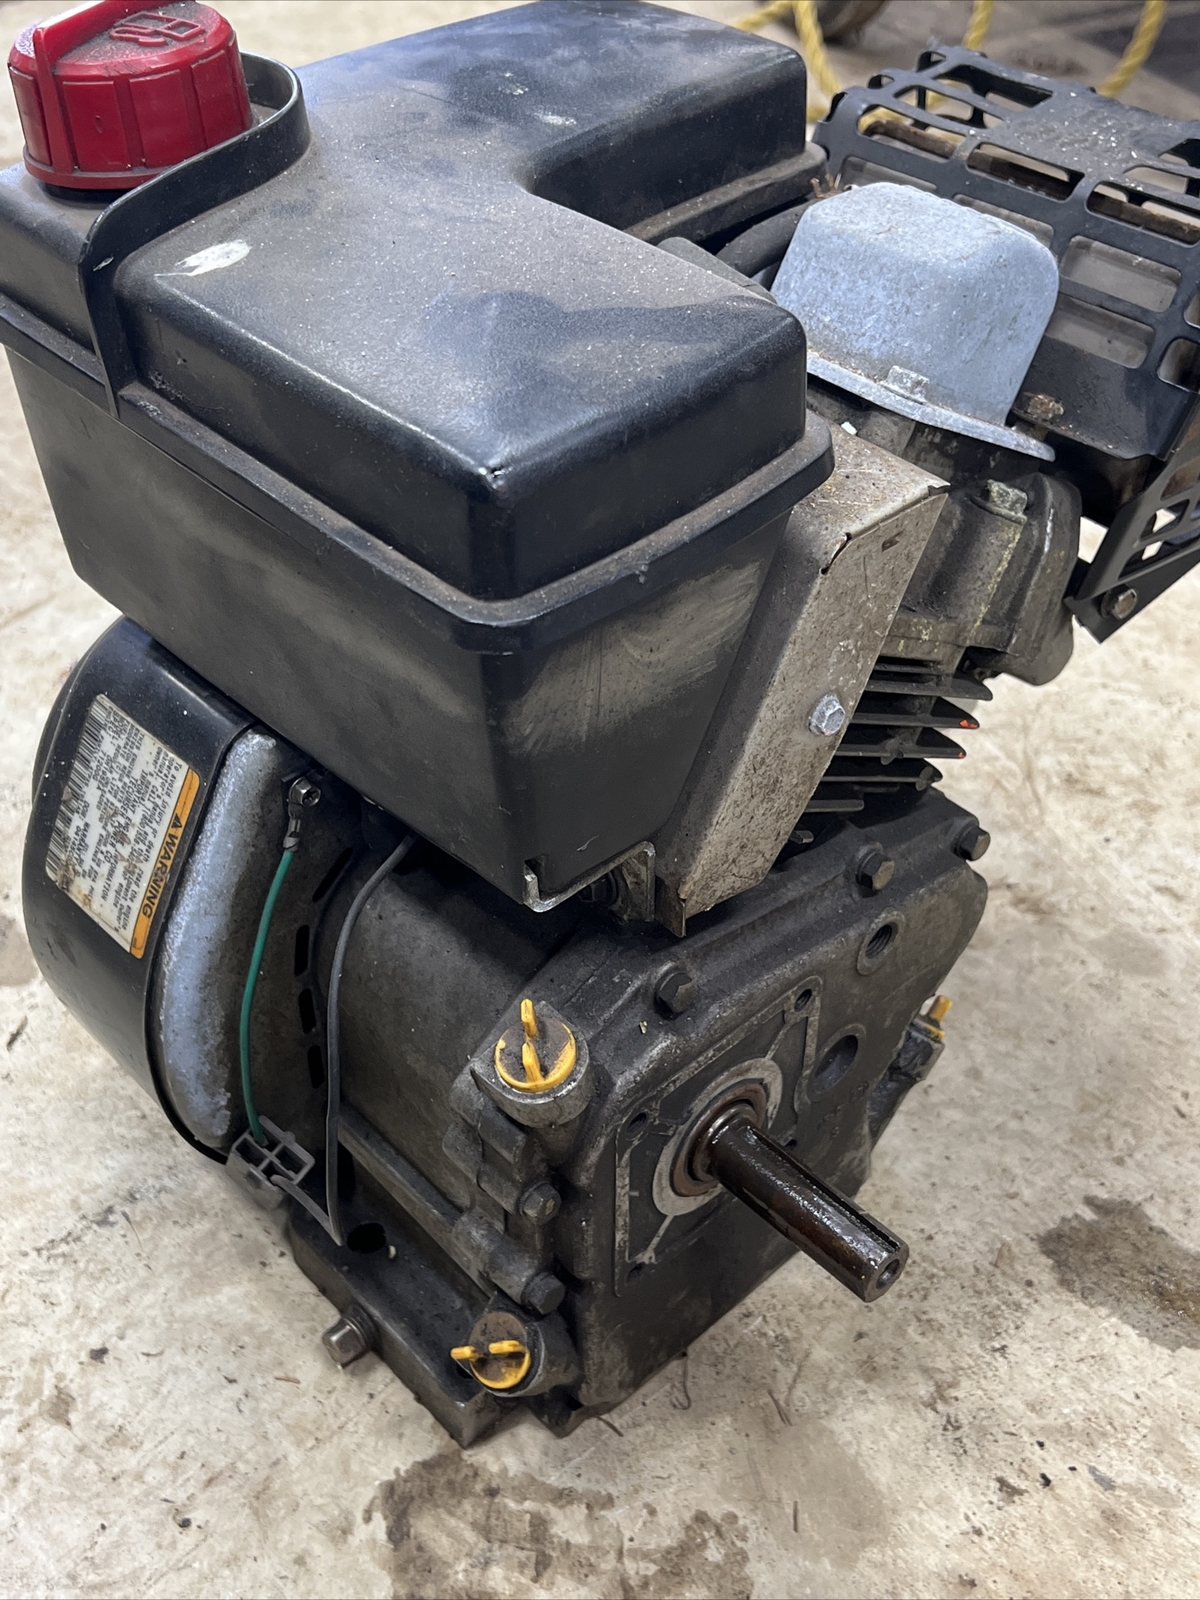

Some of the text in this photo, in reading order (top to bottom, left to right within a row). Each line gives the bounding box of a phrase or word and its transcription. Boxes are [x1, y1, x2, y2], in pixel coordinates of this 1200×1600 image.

[105, 709, 119, 737] SPEC:
[110, 715, 125, 747] MODEL:
[119, 723, 135, 759] MODERATE
[124, 727, 139, 762] EMISSION
[135, 732, 144, 751] THIS
[108, 743, 121, 774] REGULAR
[125, 752, 137, 779] ENGINE
[148, 745, 162, 778] owner's
[173, 760, 181, 773] To
[107, 776, 116, 795] LIFE
[118, 764, 127, 783] REGS
[156, 755, 174, 800] operator's
[165, 774, 177, 798] avoid
[95, 776, 110, 811] UNLEADED
[112, 785, 120, 799] FOR
[117, 780, 127, 804] MEETS
[118, 774, 137, 819] TECUMSEH
[128, 769, 148, 814] IMPORTANT
[147, 784, 158, 804] Call
[98, 796, 110, 823] PERIOD
[146, 801, 159, 829] manual
[153, 798, 168, 826] injury
[73, 820, 90, 863] WARRANTY
[108, 819, 122, 848] POWER
[140, 830, 149, 846] and
[150, 827, 157, 838] or
[91, 833, 104, 863] ENGINES
[86, 864, 94, 879] FOR
[100, 847, 120, 901] INFORMATION
[133, 867, 144, 888] read
[141, 830, 178, 920] WARNING
[111, 881, 124, 909] engine
[128, 888, 137, 904] the
[114, 902, 125, 933] owner's
[120, 903, 132, 931] engine
